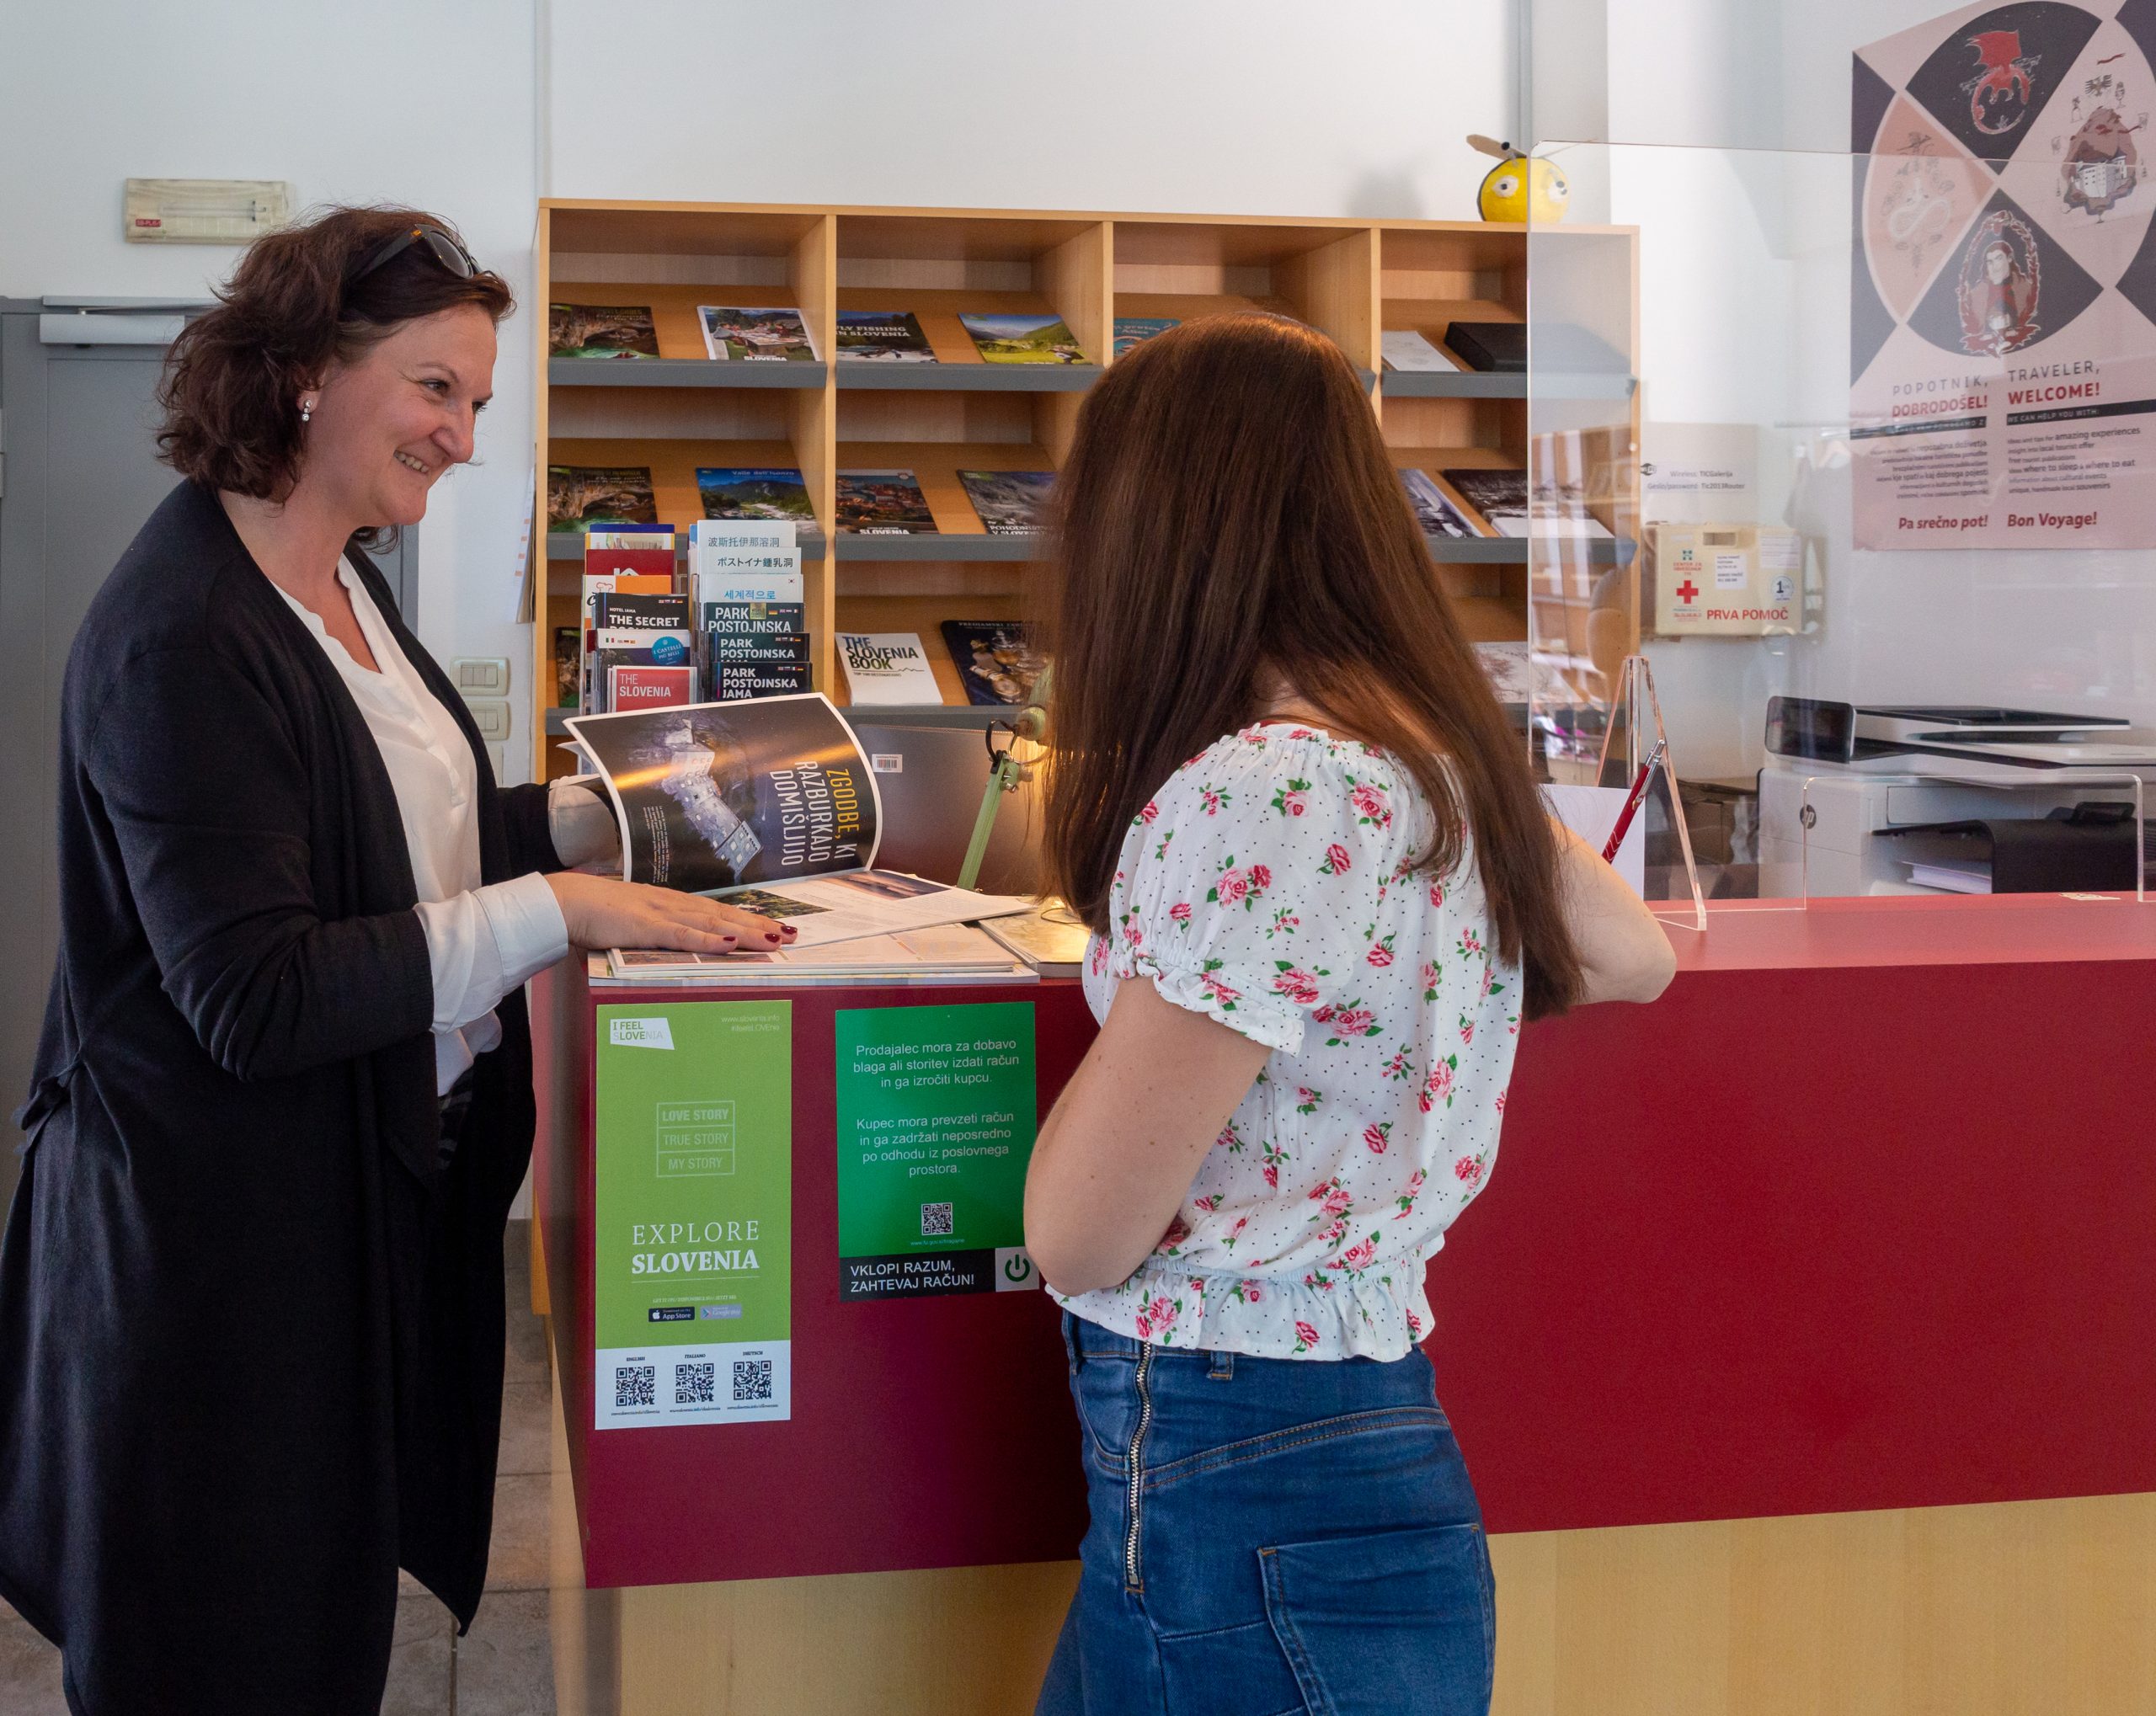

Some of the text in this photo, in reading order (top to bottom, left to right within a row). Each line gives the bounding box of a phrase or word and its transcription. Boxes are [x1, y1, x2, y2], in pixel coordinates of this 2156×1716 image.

[2009, 360, 2100, 382] TRAVELER,
[1893, 376, 1988, 396] POPOTNIK,
[2009, 382, 2100, 405] WELCOME!
[1892, 393, 1988, 418] DOBRODOŠEL!
[2055, 431, 2089, 440] amazing
[2091, 427, 2141, 439] experiences
[1917, 514, 1959, 530] srečno
[1961, 514, 1988, 530] pot!
[2008, 511, 2097, 529] Bon Voyage!
[708, 536, 780, 547] 波斯托伊那溶洞
[718, 557, 793, 568] ポストイナ鍾乳洞
[724, 589, 776, 600] 세계적으로
[609, 614, 680, 626] THE SECRET
[715, 607, 750, 620] PARK
[1706, 609, 1739, 621] PRVA
[1742, 606, 1789, 621] POMOČ
[708, 621, 792, 633] POSTOJNSKA
[657, 644, 681, 654] CASTELLI
[720, 638, 754, 648] PARK
[842, 636, 871, 649] THE
[720, 648, 796, 658] POSTOJNSKA
[846, 647, 920, 659] SLOVENIA
[848, 656, 894, 670] BOOK
[619, 674, 638, 685] THE
[723, 668, 756, 678] PARK
[723, 678, 798, 688] POSTOJNSKA
[619, 686, 672, 697] SLOVENIA
[723, 689, 753, 699] JAMA
[770, 770, 809, 866] DOMIŠLJIJO
[794, 760, 834, 862] RAZBURKAJO
[826, 768, 860, 859] ZGODBE, KI
[613, 1021, 643, 1031] I FEEL
[613, 1031, 664, 1042] SLOVENIA
[856, 1039, 1017, 1057] Prodajalec mora za dobavo
[853, 1054, 1020, 1074] blaga ali storitev izdati račun
[881, 1073, 992, 1090] in ga izročiti kupcu.
[662, 1108, 729, 1122] LOVE STORY
[857, 1111, 1014, 1132] Kupec mora prevzeti račun
[663, 1132, 729, 1147] TRUE STORY
[860, 1128, 1011, 1148] in ga zadržati neposredno
[862, 1145, 1009, 1164] po odhodu iz poslovnega
[668, 1157, 723, 1170] MY STORY
[909, 1164, 961, 1178] prostora.
[632, 1220, 760, 1246] EXPLORE
[632, 1249, 760, 1275] SLOVENIA
[850, 1260, 955, 1276] VKLOPI RAZUM,
[851, 1273, 975, 1292] ZAHTEVAJ RAČUN!
